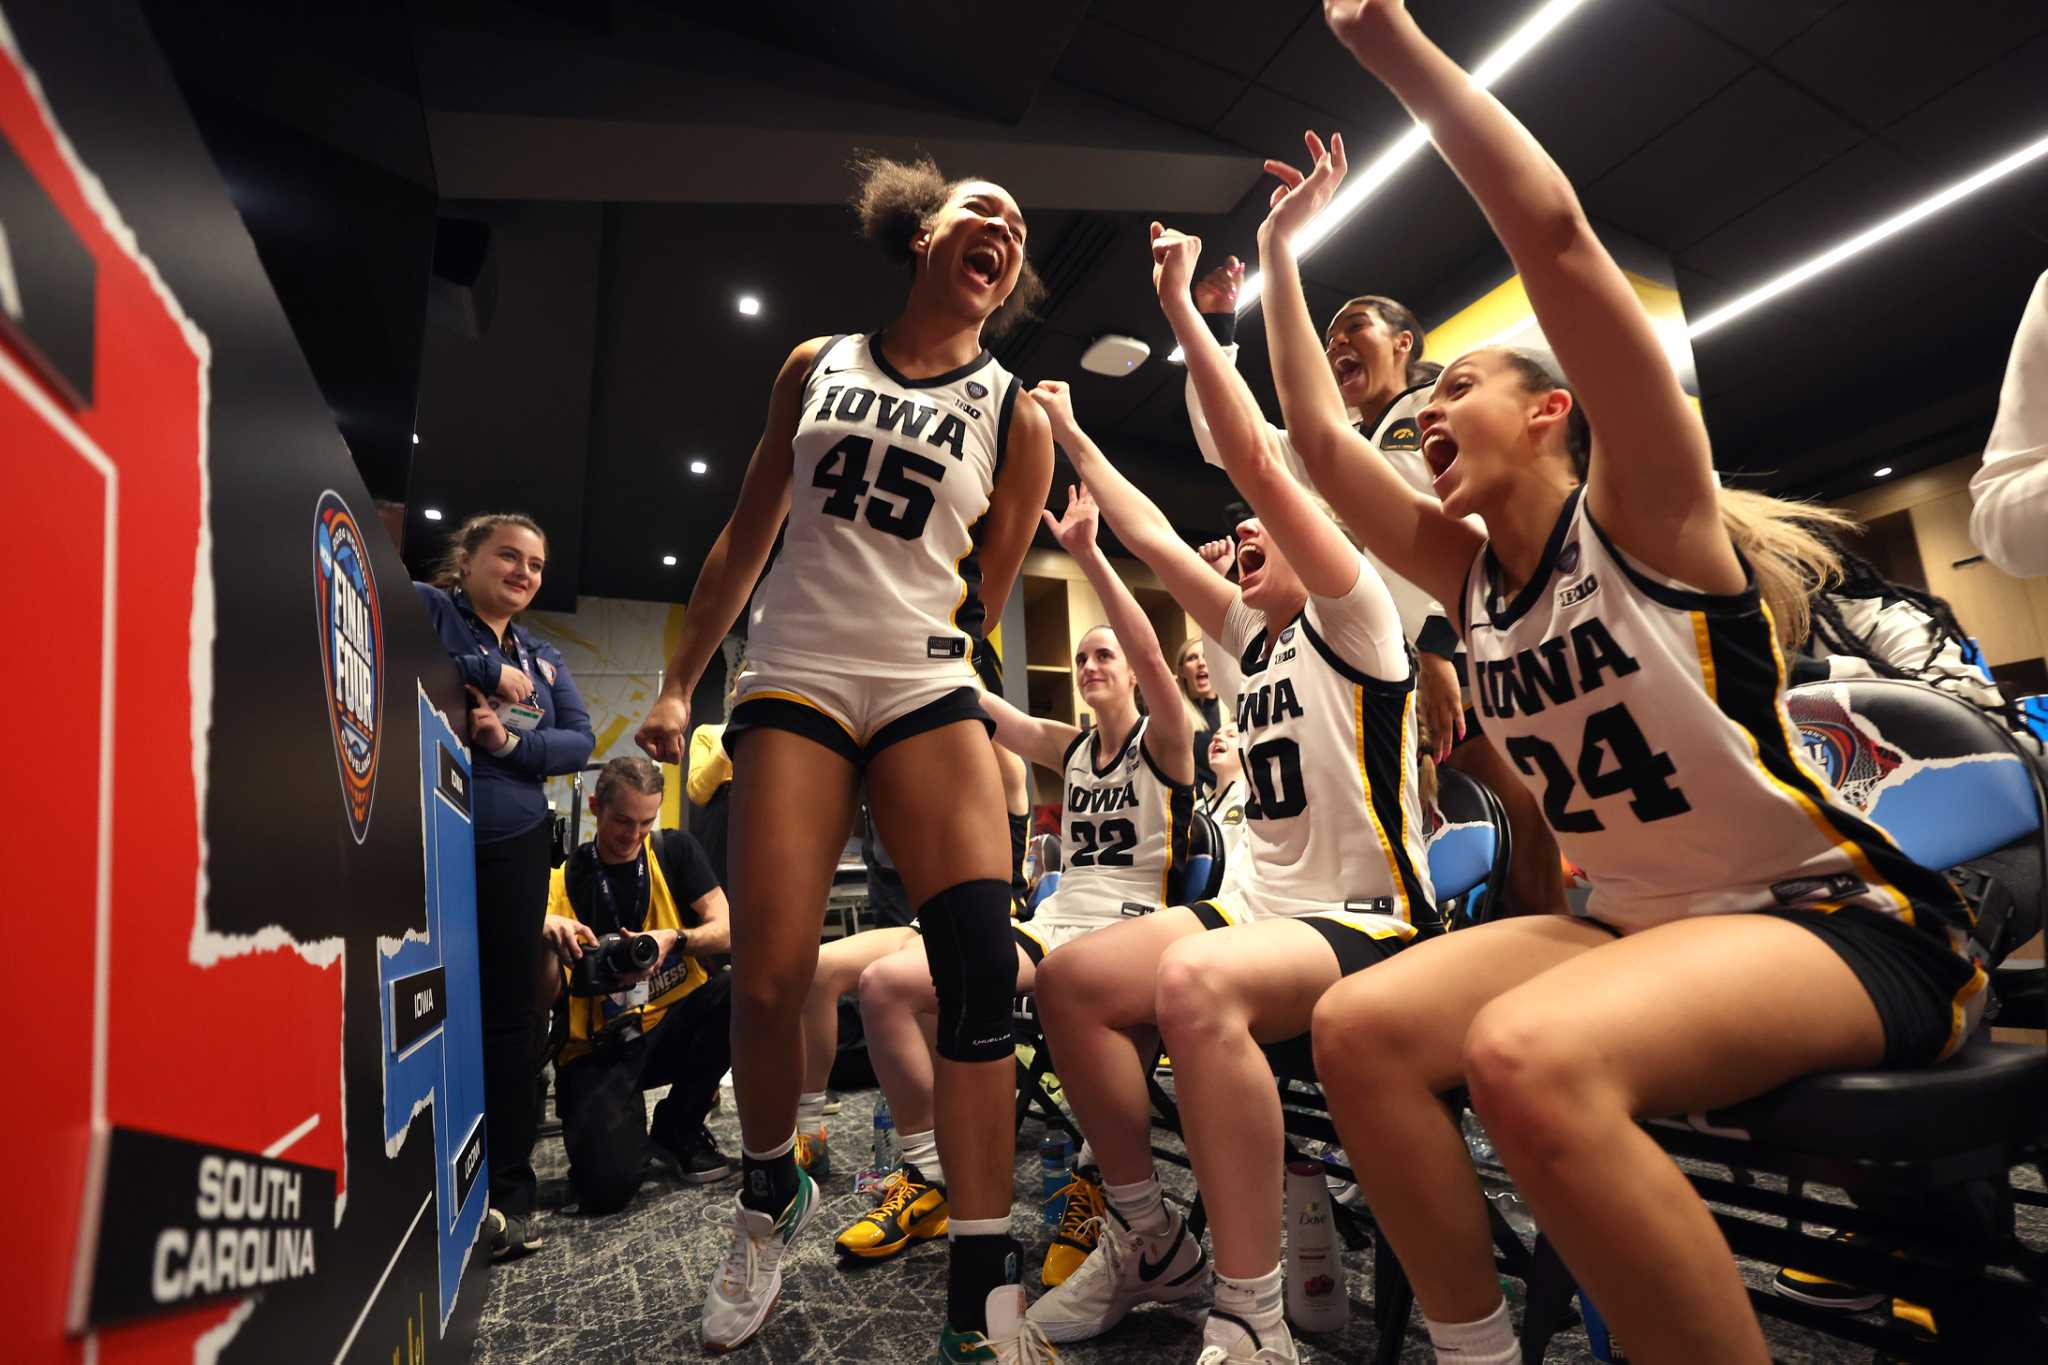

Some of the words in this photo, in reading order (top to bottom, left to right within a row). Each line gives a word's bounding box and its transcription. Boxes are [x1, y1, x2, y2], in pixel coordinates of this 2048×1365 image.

[815, 385, 967, 461] IOWA
[812, 434, 947, 541] 45
[333, 560, 371, 667] FINAL
[335, 627, 374, 732] FOUR
[1237, 677, 1304, 733] WA
[1475, 616, 1641, 719] IOWA
[1504, 702, 1693, 833] 24
[1070, 818, 1138, 867] 22
[414, 988, 434, 1020] IOWA
[197, 1155, 302, 1220] SOUTH
[1298, 1213, 1327, 1225] Dove
[152, 1228, 316, 1302] CAROLINA
